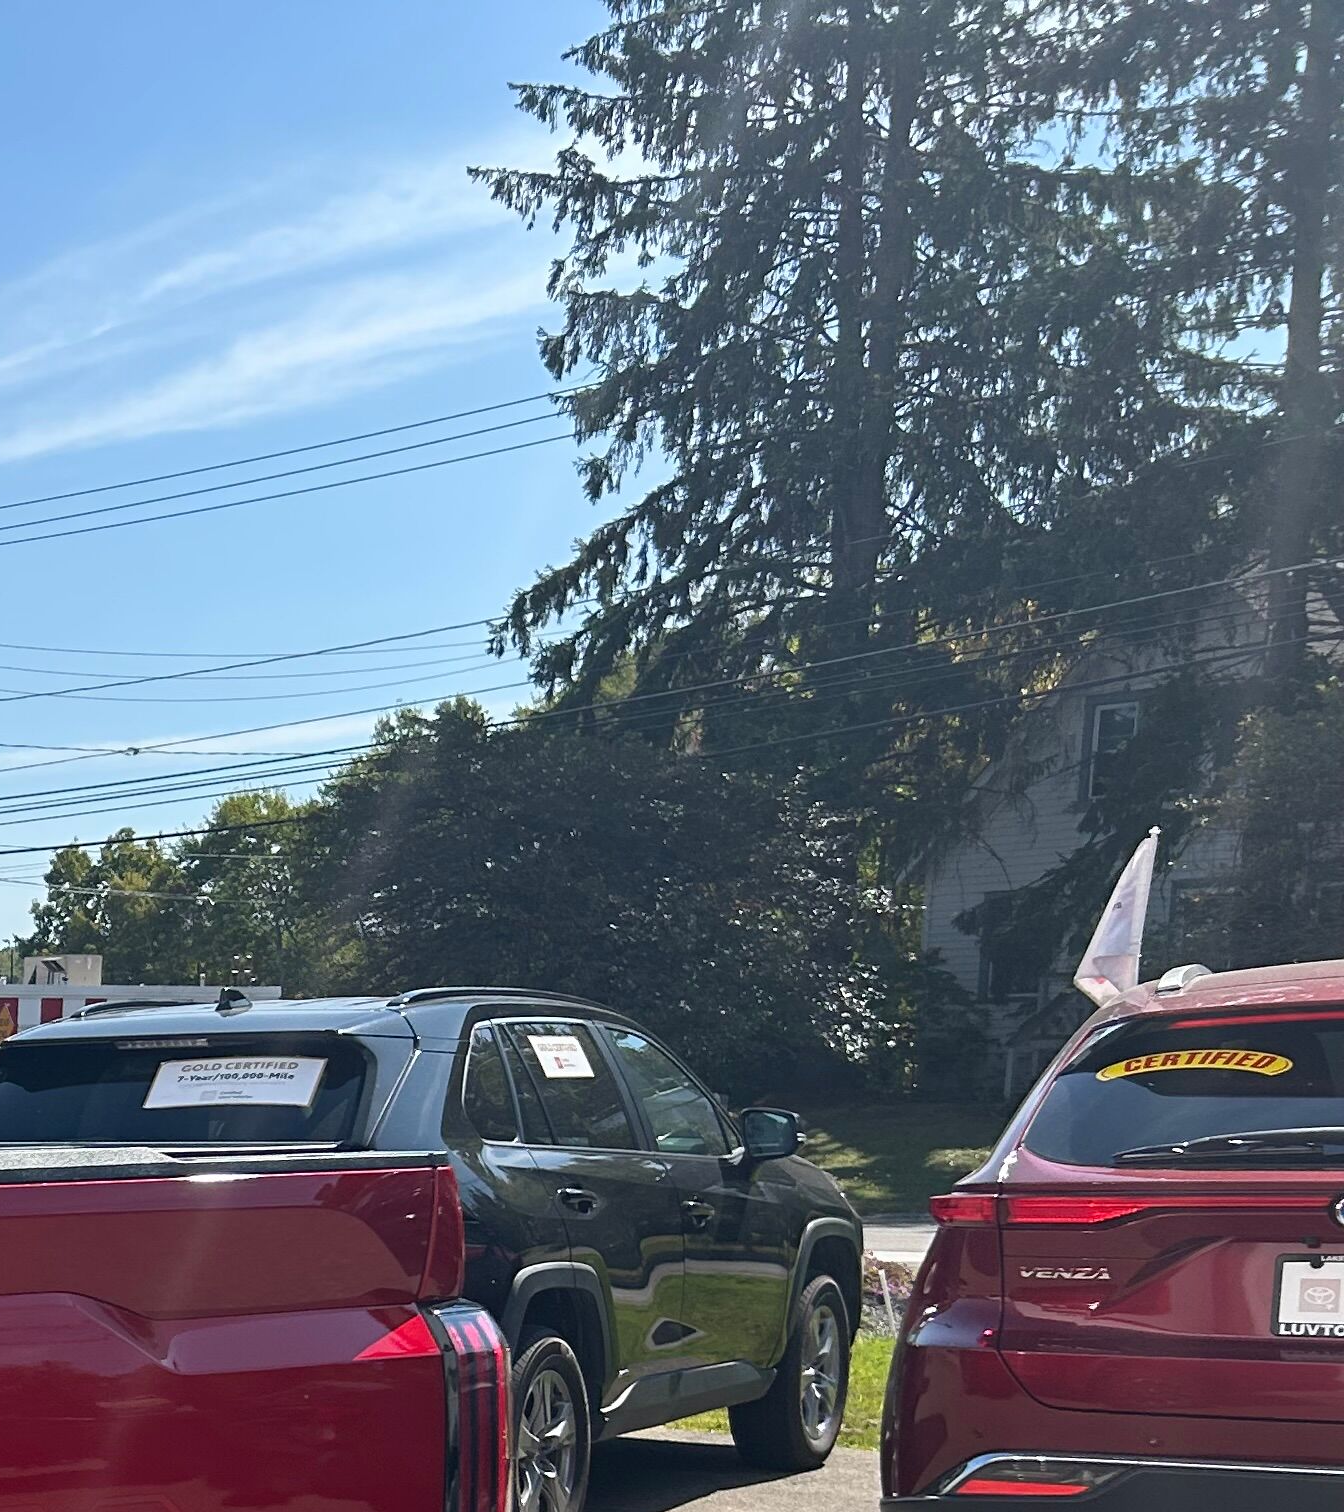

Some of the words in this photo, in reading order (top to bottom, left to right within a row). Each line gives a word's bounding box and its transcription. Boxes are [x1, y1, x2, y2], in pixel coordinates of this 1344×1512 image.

[181, 1062, 223, 1073] GOLD
[224, 1060, 300, 1071] CERTIFIED
[1123, 1050, 1278, 1073] CERTIFIED
[1019, 1266, 1112, 1281] VENZA
